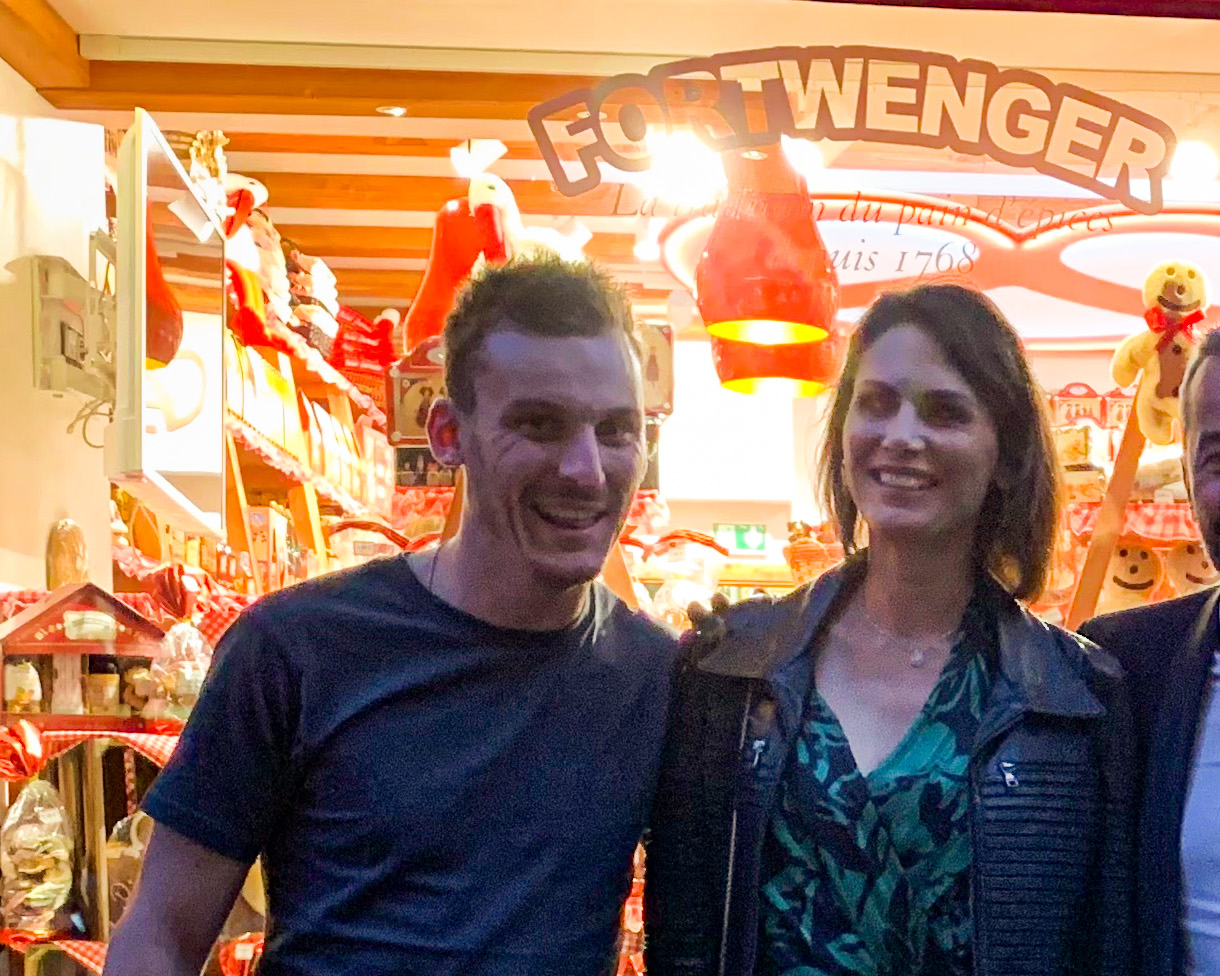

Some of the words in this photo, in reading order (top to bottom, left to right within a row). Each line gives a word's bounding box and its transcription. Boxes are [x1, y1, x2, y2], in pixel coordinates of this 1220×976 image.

[529, 45, 1176, 215] FORTWENGER
[610, 184, 659, 217] La
[838, 190, 883, 224] du
[892, 201, 973, 236] pain
[895, 241, 977, 275] 1768
